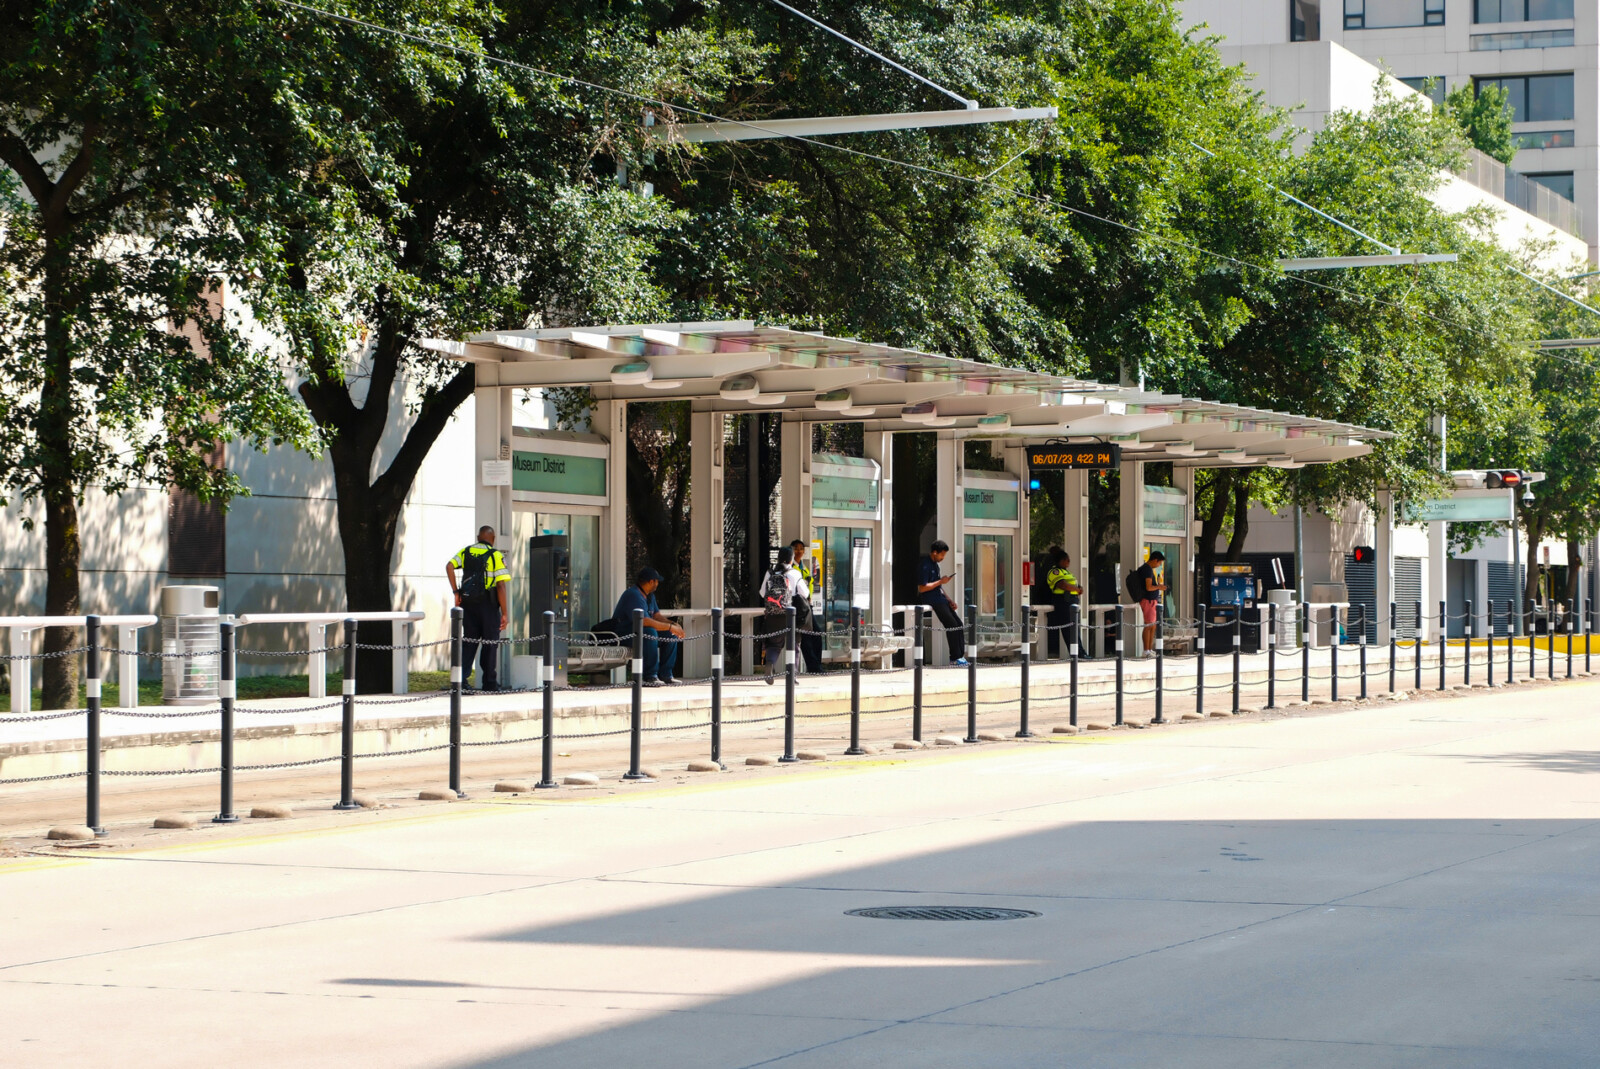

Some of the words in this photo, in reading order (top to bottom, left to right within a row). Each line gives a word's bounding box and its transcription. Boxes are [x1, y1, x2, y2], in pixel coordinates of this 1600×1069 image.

[512, 455, 541, 472] Museum
[543, 457, 565, 474] District
[1033, 454, 1073, 464] 06/07/23
[1077, 453, 1093, 464] 4:22
[1098, 453, 1110, 463] PM
[981, 491, 994, 504] District
